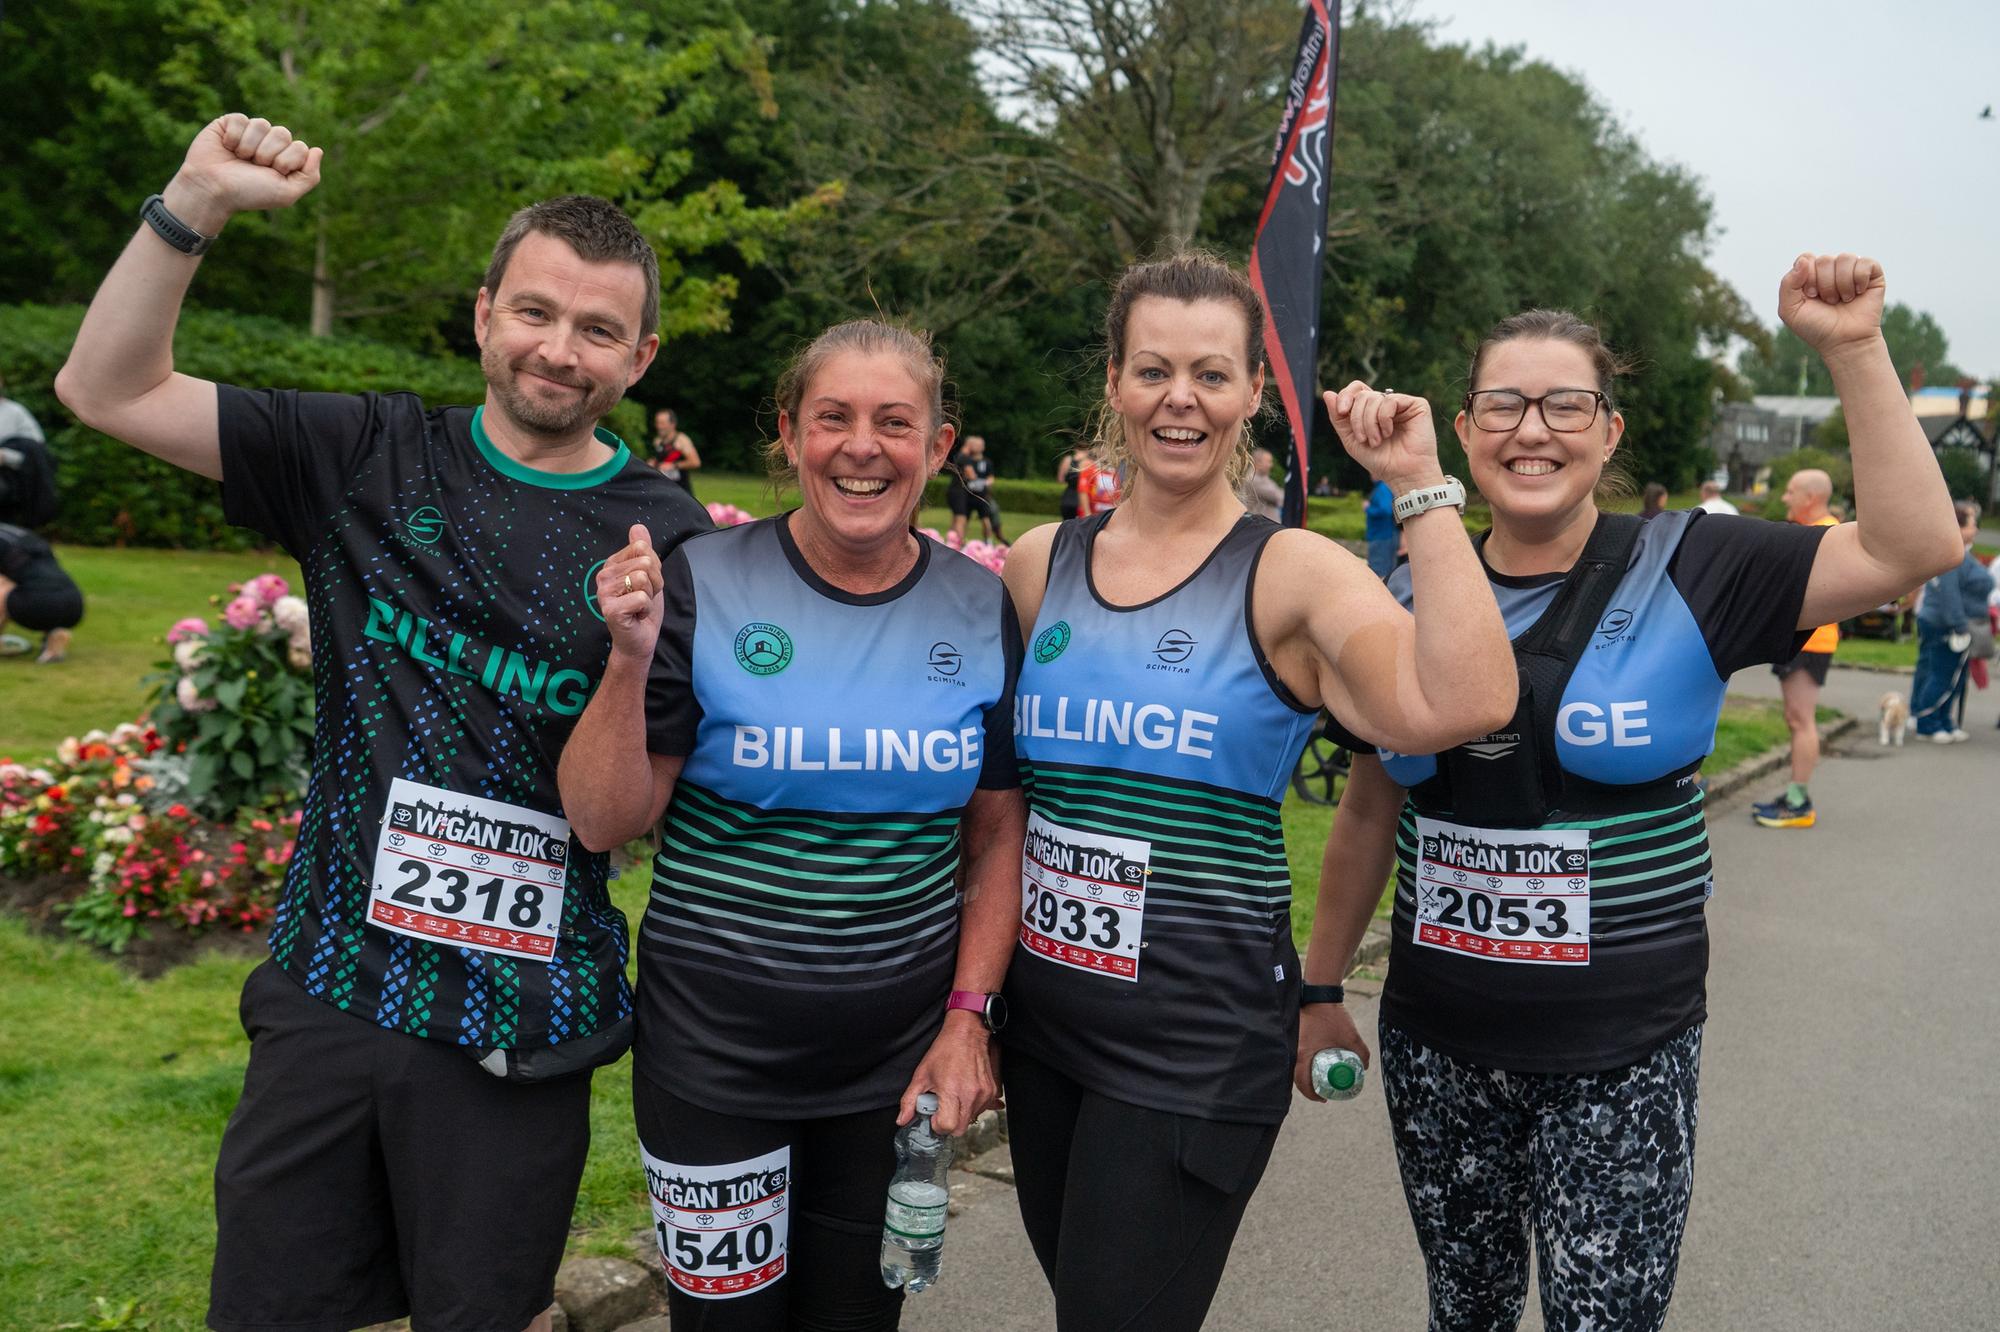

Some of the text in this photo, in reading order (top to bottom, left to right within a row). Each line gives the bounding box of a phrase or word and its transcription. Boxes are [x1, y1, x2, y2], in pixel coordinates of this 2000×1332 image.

[364, 595, 601, 716] BILLING
[1145, 663, 1190, 674] SCIMITAR
[927, 675, 966, 687] SCIMITAR
[732, 724, 980, 773] BILLINGE
[505, 828, 550, 861] 10K
[1514, 850, 1563, 873] 10K
[1079, 852, 1121, 883] 10K
[390, 859, 544, 929] 2318
[1436, 886, 1570, 939] 2053
[1024, 882, 1121, 950] 2933
[725, 1174, 769, 1207] 10K
[656, 1221, 773, 1272] 1540
